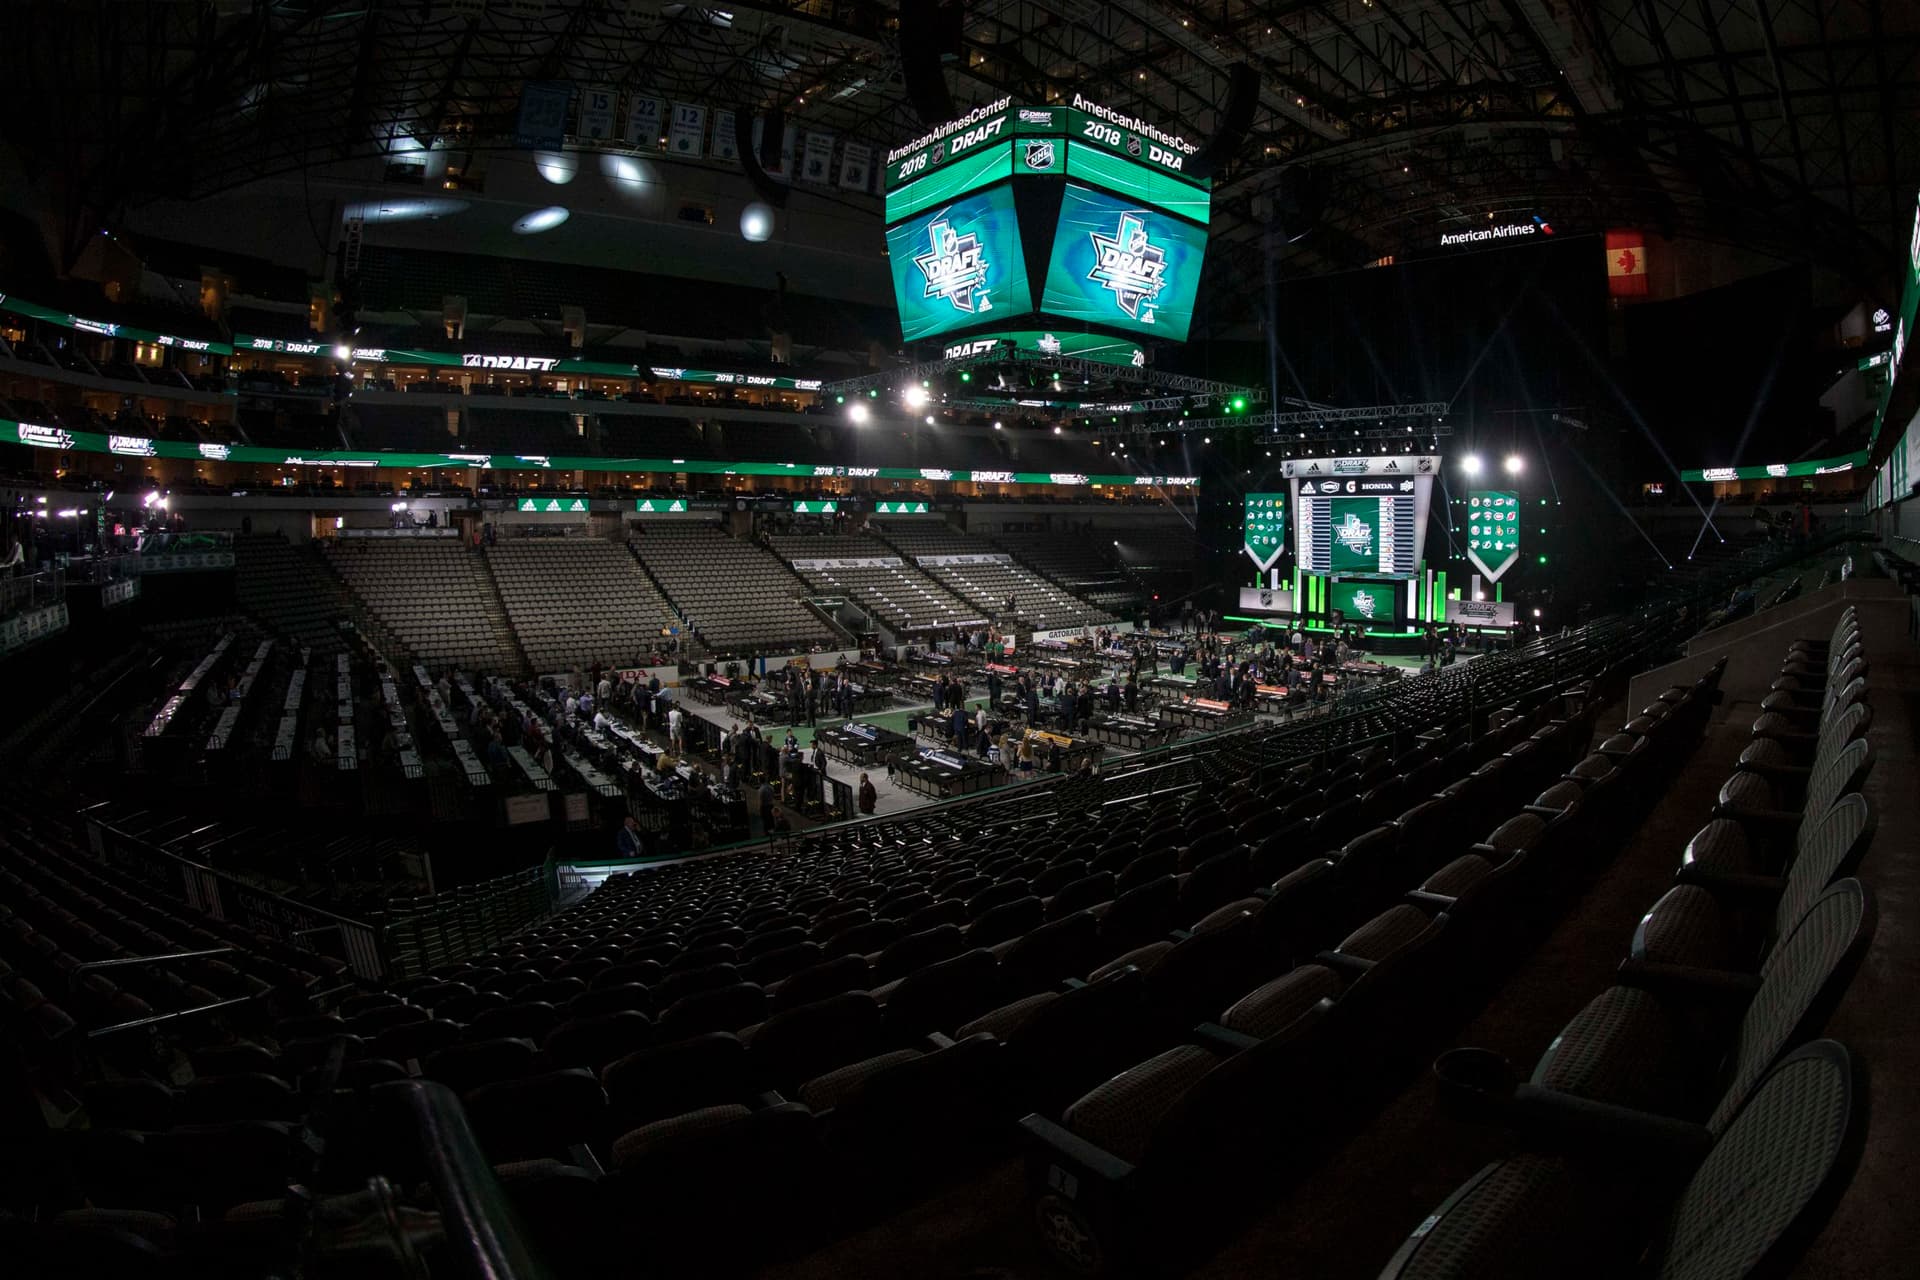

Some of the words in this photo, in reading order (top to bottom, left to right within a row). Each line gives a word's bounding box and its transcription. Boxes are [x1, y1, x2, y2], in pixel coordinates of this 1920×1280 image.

[592, 94, 608, 110] 15
[639, 100, 655, 116] 22
[682, 109, 698, 123] 12
[898, 153, 928, 180] 2018
[951, 116, 1007, 154] DRAFT
[1083, 121, 1121, 146] 2018
[1148, 144, 1183, 171] DRA
[1030, 148, 1050, 165] NHL
[1440, 230, 1492, 246] American
[1493, 224, 1536, 240] Airlines
[927, 246, 983, 281] DRAFT
[1101, 246, 1166, 279] DRAFT
[183, 341, 209, 351] DRAFT
[253, 339, 273, 349] 2018
[286, 343, 320, 354] DRAFT
[356, 349, 385, 358] DRAFT
[1131, 350, 1144, 368] 20
[715, 374, 734, 383] 2018
[747, 377, 776, 386] DRAFT
[813, 467, 834, 476] 2018
[848, 468, 879, 477] DRAFT
[979, 472, 1010, 481] DRAFT
[1166, 477, 1197, 485] DRAFT
[1341, 528, 1370, 537] DRAFT
[1467, 603, 1496, 611] DRAFT
[1049, 628, 1083, 639] GATORADE
